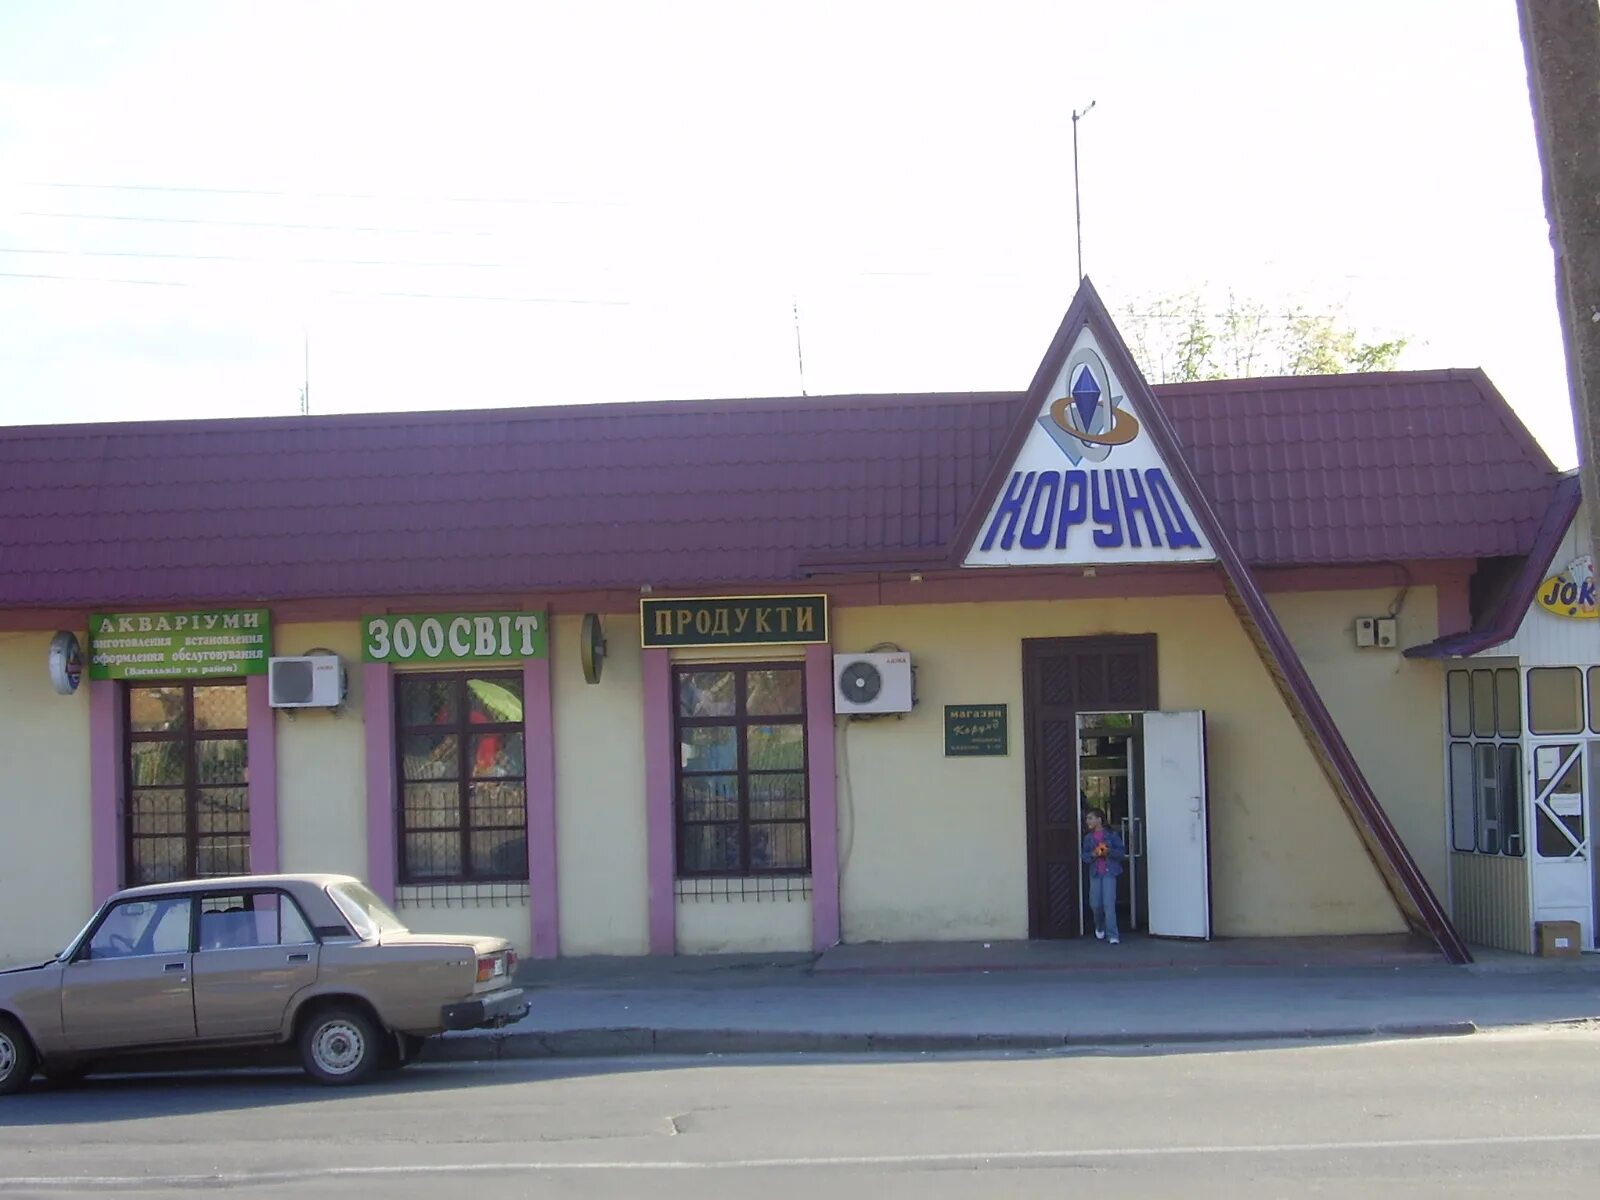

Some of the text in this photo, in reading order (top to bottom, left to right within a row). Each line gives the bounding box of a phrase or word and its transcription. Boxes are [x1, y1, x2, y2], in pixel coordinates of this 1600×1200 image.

[980, 468, 1201, 551] КОРУНД
[99, 613, 259, 633] АКВАРІУМИ
[655, 606, 814, 636] ПРОДУКТИ
[185, 634, 264, 646] встановлення
[368, 615, 538, 658] ЗООСВІТ
[92, 647, 264, 666] оформлення обслуговування
